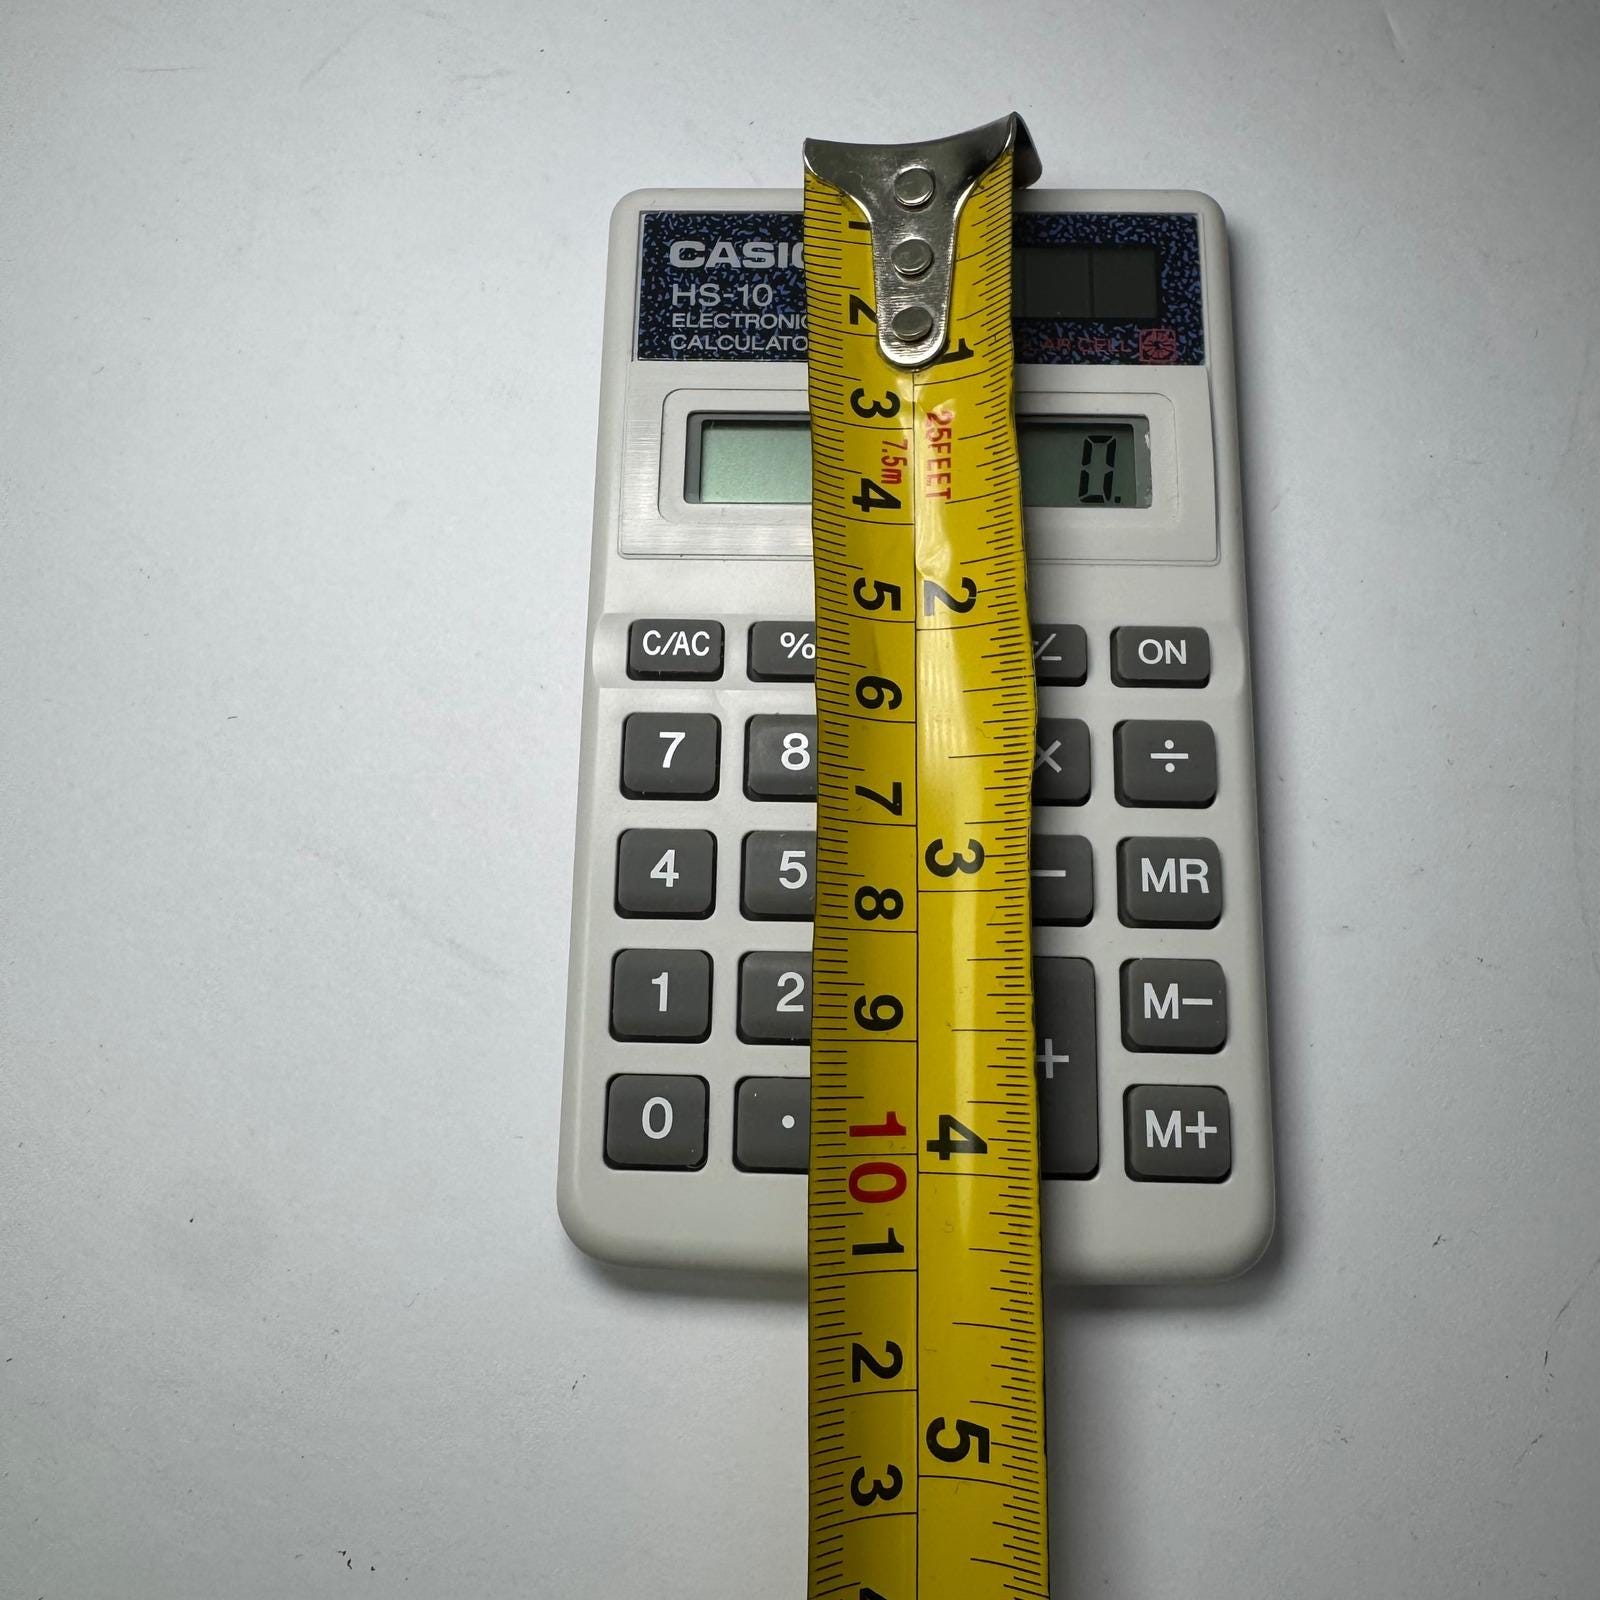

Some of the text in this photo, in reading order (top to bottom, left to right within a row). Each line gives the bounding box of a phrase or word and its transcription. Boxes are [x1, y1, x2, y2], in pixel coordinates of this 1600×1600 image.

[672, 283, 774, 307] HS-10
[670, 333, 809, 351] CALCULATO
[1077, 336, 1133, 353] CELL
[850, 388, 901, 419] 3
[881, 439, 908, 485] 7.5m
[852, 478, 901, 512] 4
[853, 577, 901, 611] 5
[923, 577, 978, 617] 2
[642, 630, 711, 656] C/AC
[1138, 638, 1187, 665] ON
[855, 675, 902, 710] 6
[659, 731, 686, 769] 7
[781, 732, 811, 770] 8
[855, 781, 902, 816] 7
[650, 849, 680, 888] 4
[779, 850, 808, 889] 5
[925, 838, 985, 877] 3
[1140, 857, 1210, 894] MR
[854, 885, 904, 921] 8
[651, 971, 669, 1012] 1
[776, 971, 805, 1012] 2
[1143, 982, 1213, 1020] M-
[854, 994, 904, 1032] 9
[642, 1096, 674, 1140] 0
[1145, 1109, 1218, 1149] M+
[926, 1114, 988, 1161] 4
[851, 1227, 905, 1256] 1
[851, 1340, 902, 1383] 2
[925, 1416, 991, 1464] 5
[850, 1464, 903, 1508] 3
